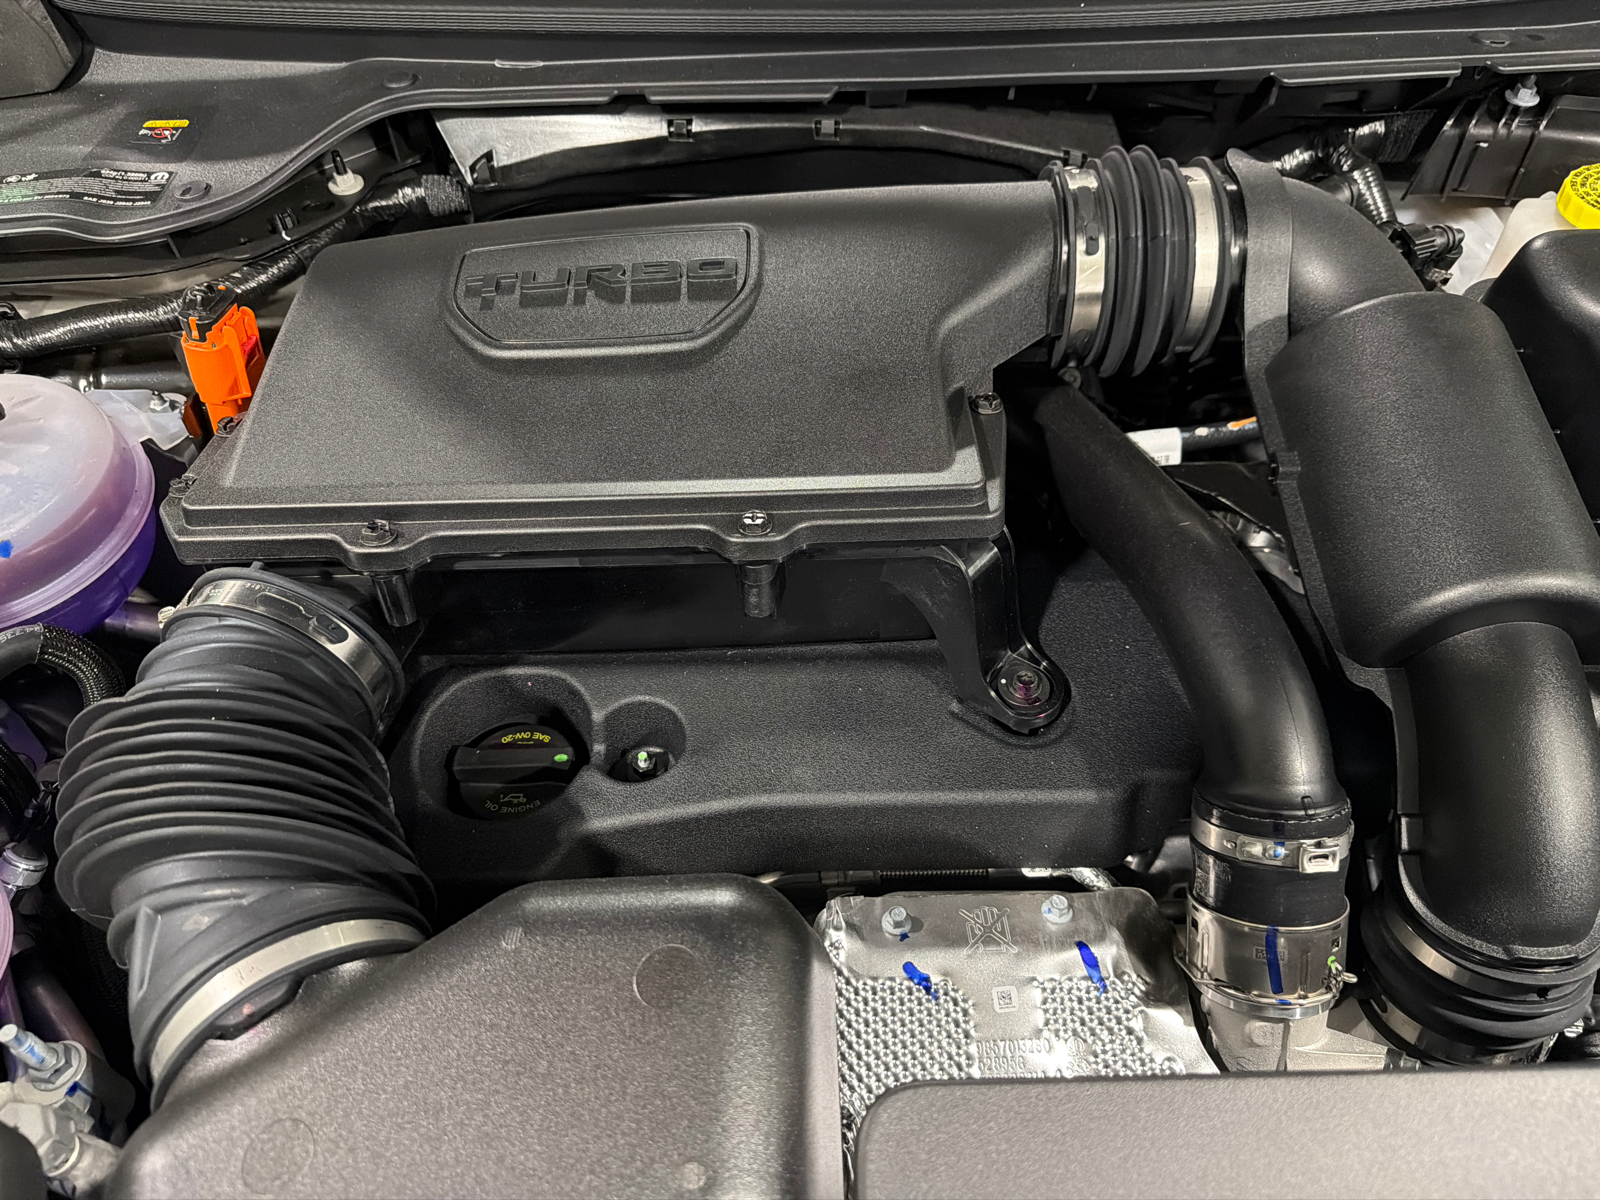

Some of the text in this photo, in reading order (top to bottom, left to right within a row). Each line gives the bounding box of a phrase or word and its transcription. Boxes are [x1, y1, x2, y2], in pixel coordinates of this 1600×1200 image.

[464, 256, 738, 300] TURBO
[501, 731, 551, 744] SAE 0W-20
[484, 799, 541, 813] ENGINE OIL
